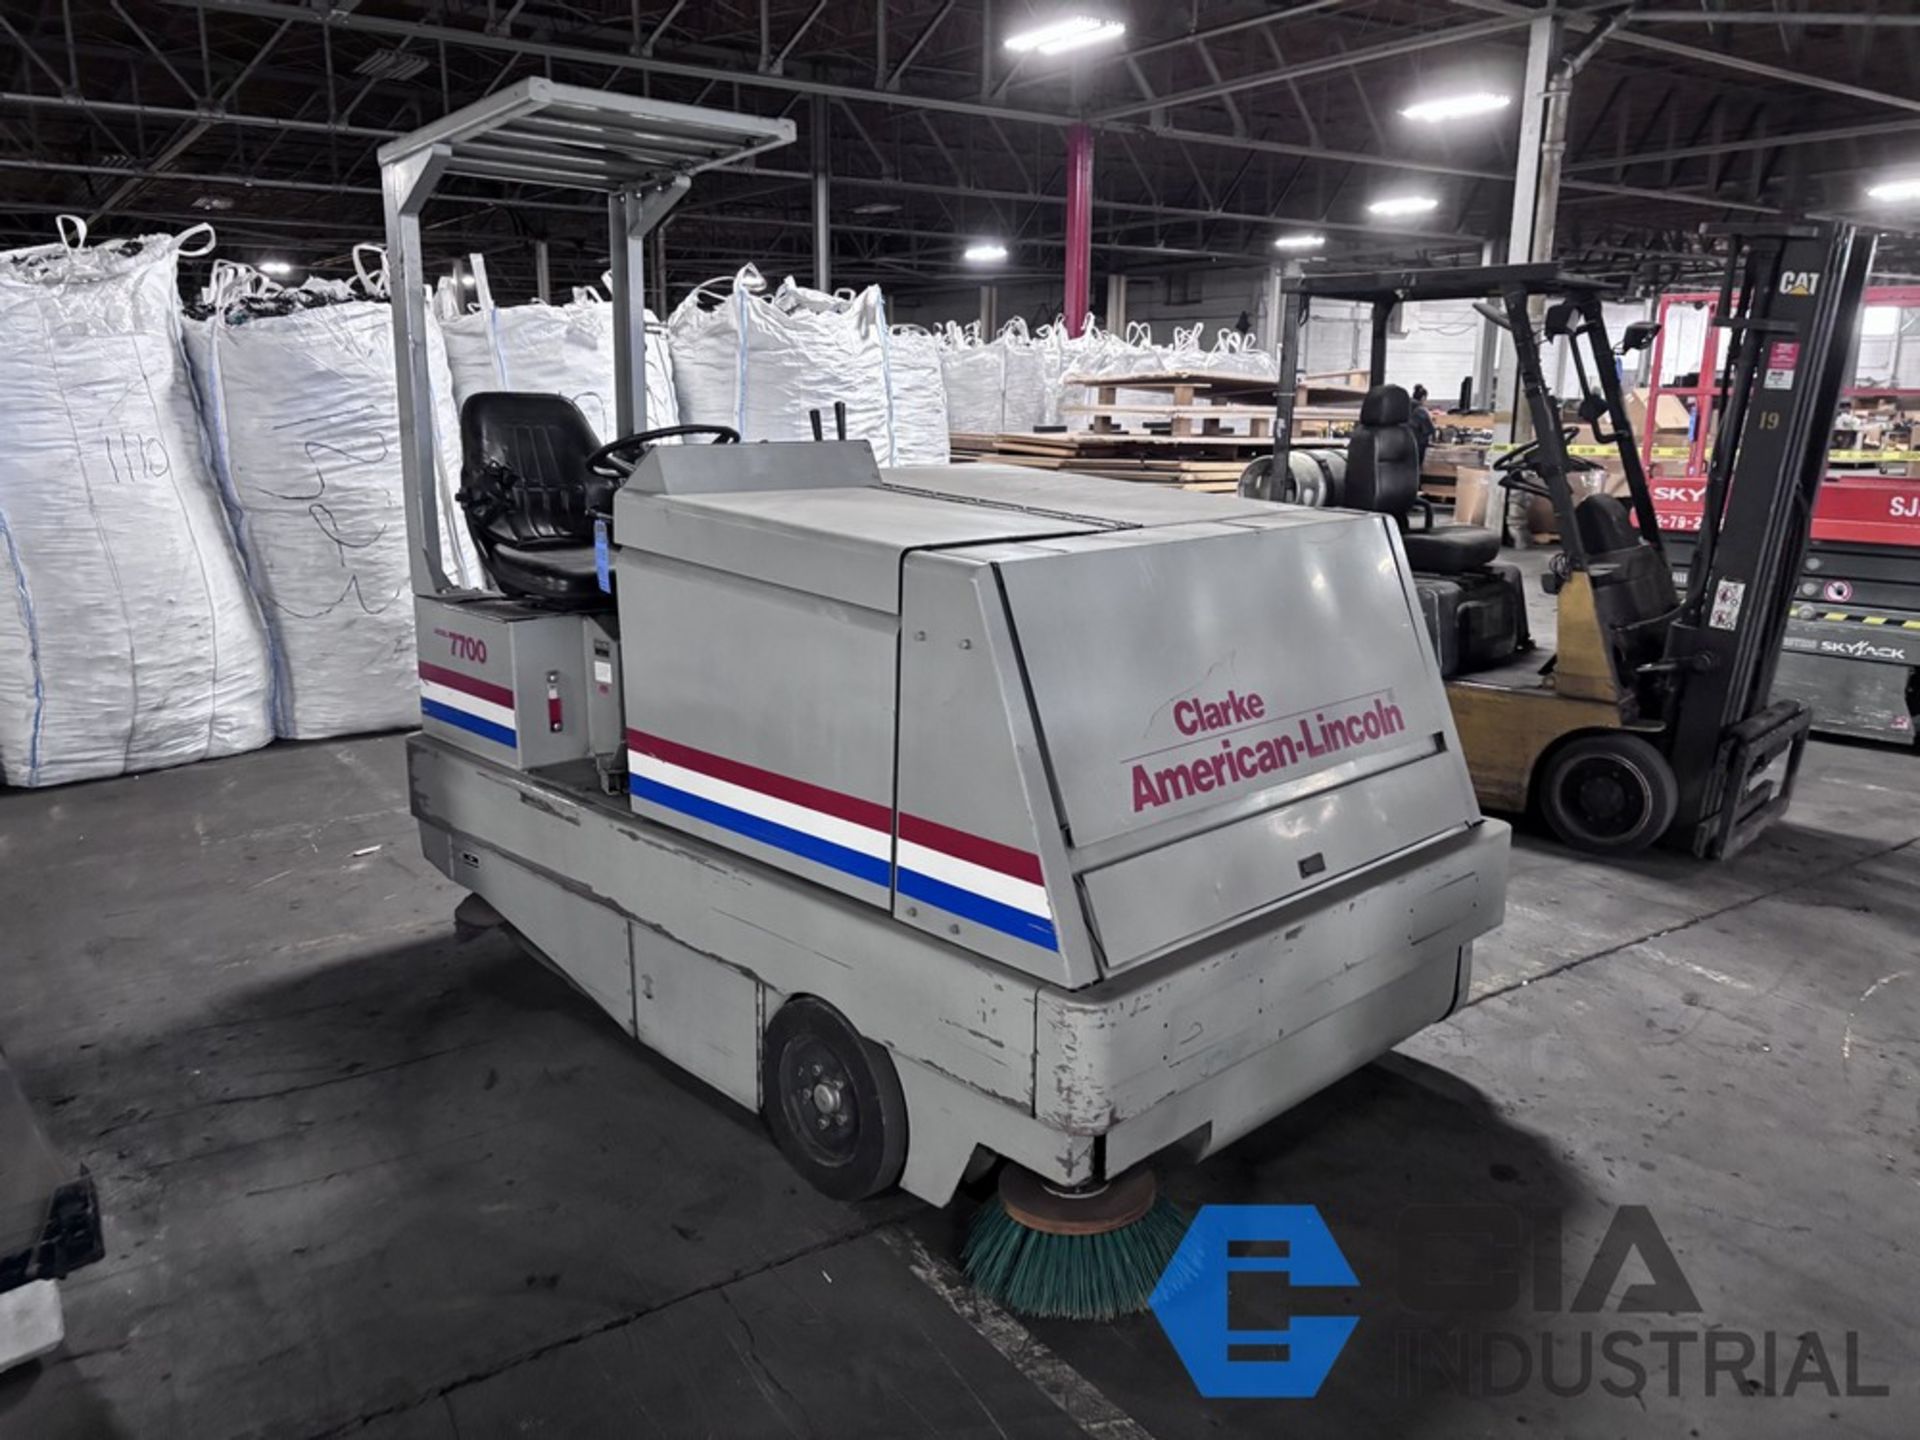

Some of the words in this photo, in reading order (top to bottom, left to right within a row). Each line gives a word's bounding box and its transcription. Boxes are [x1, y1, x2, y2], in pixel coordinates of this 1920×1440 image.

[1779, 270, 1820, 295] CAT
[1759, 411, 1780, 430] 19
[1889, 496, 1920, 517] SJ
[449, 631, 487, 664] 7700
[1821, 640, 1905, 660] SKYJACK
[1173, 690, 1265, 736] Clarke
[1131, 698, 1405, 812] American-Lincoln
